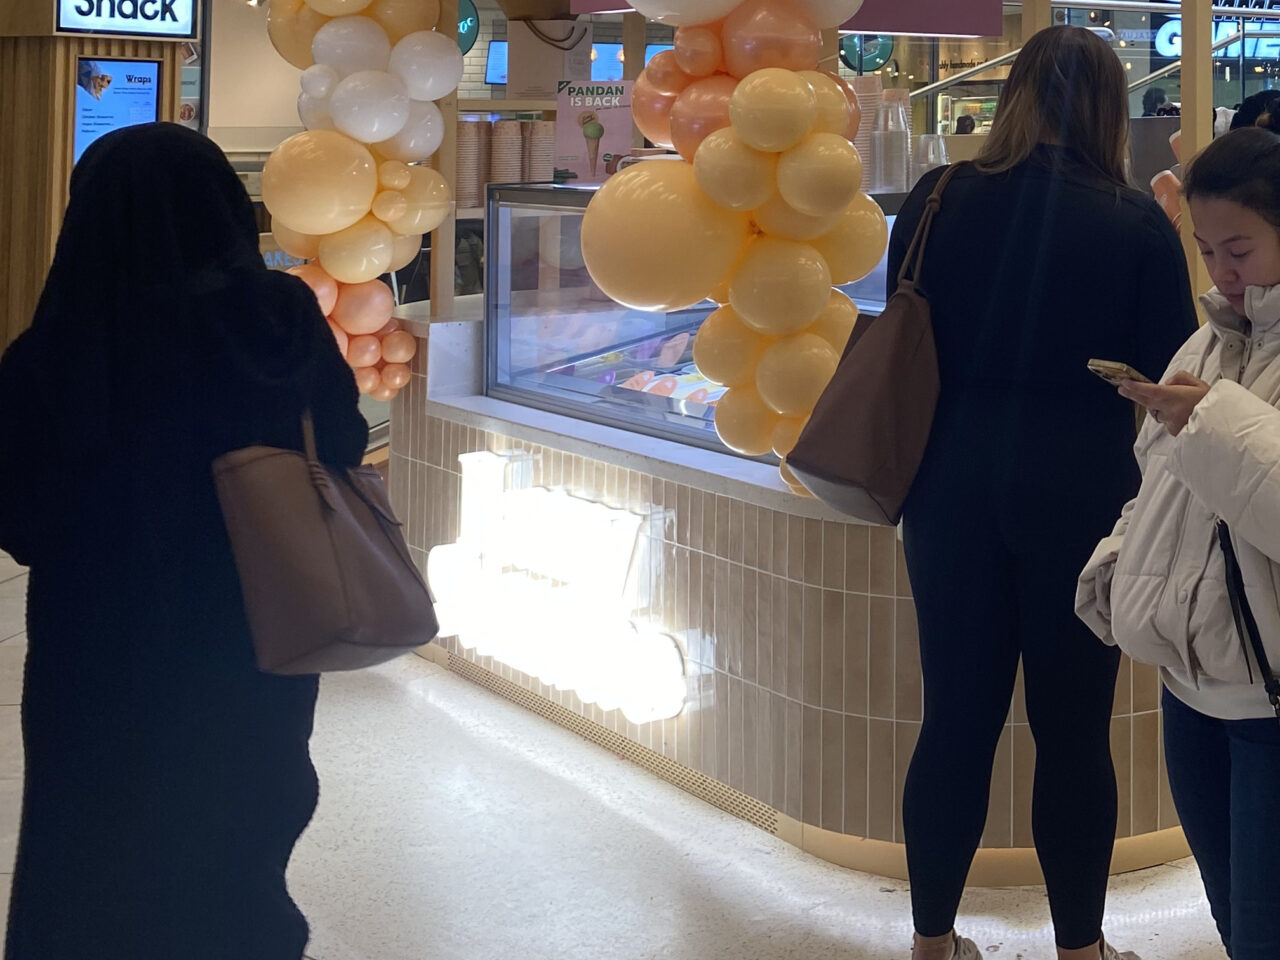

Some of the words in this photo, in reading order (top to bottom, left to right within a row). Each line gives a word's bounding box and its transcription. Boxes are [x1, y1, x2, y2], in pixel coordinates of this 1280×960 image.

[125, 73, 152, 85] Wraps
[567, 85, 625, 97] PANDAN
[570, 97, 582, 107] IS
[585, 96, 621, 107] BACK
